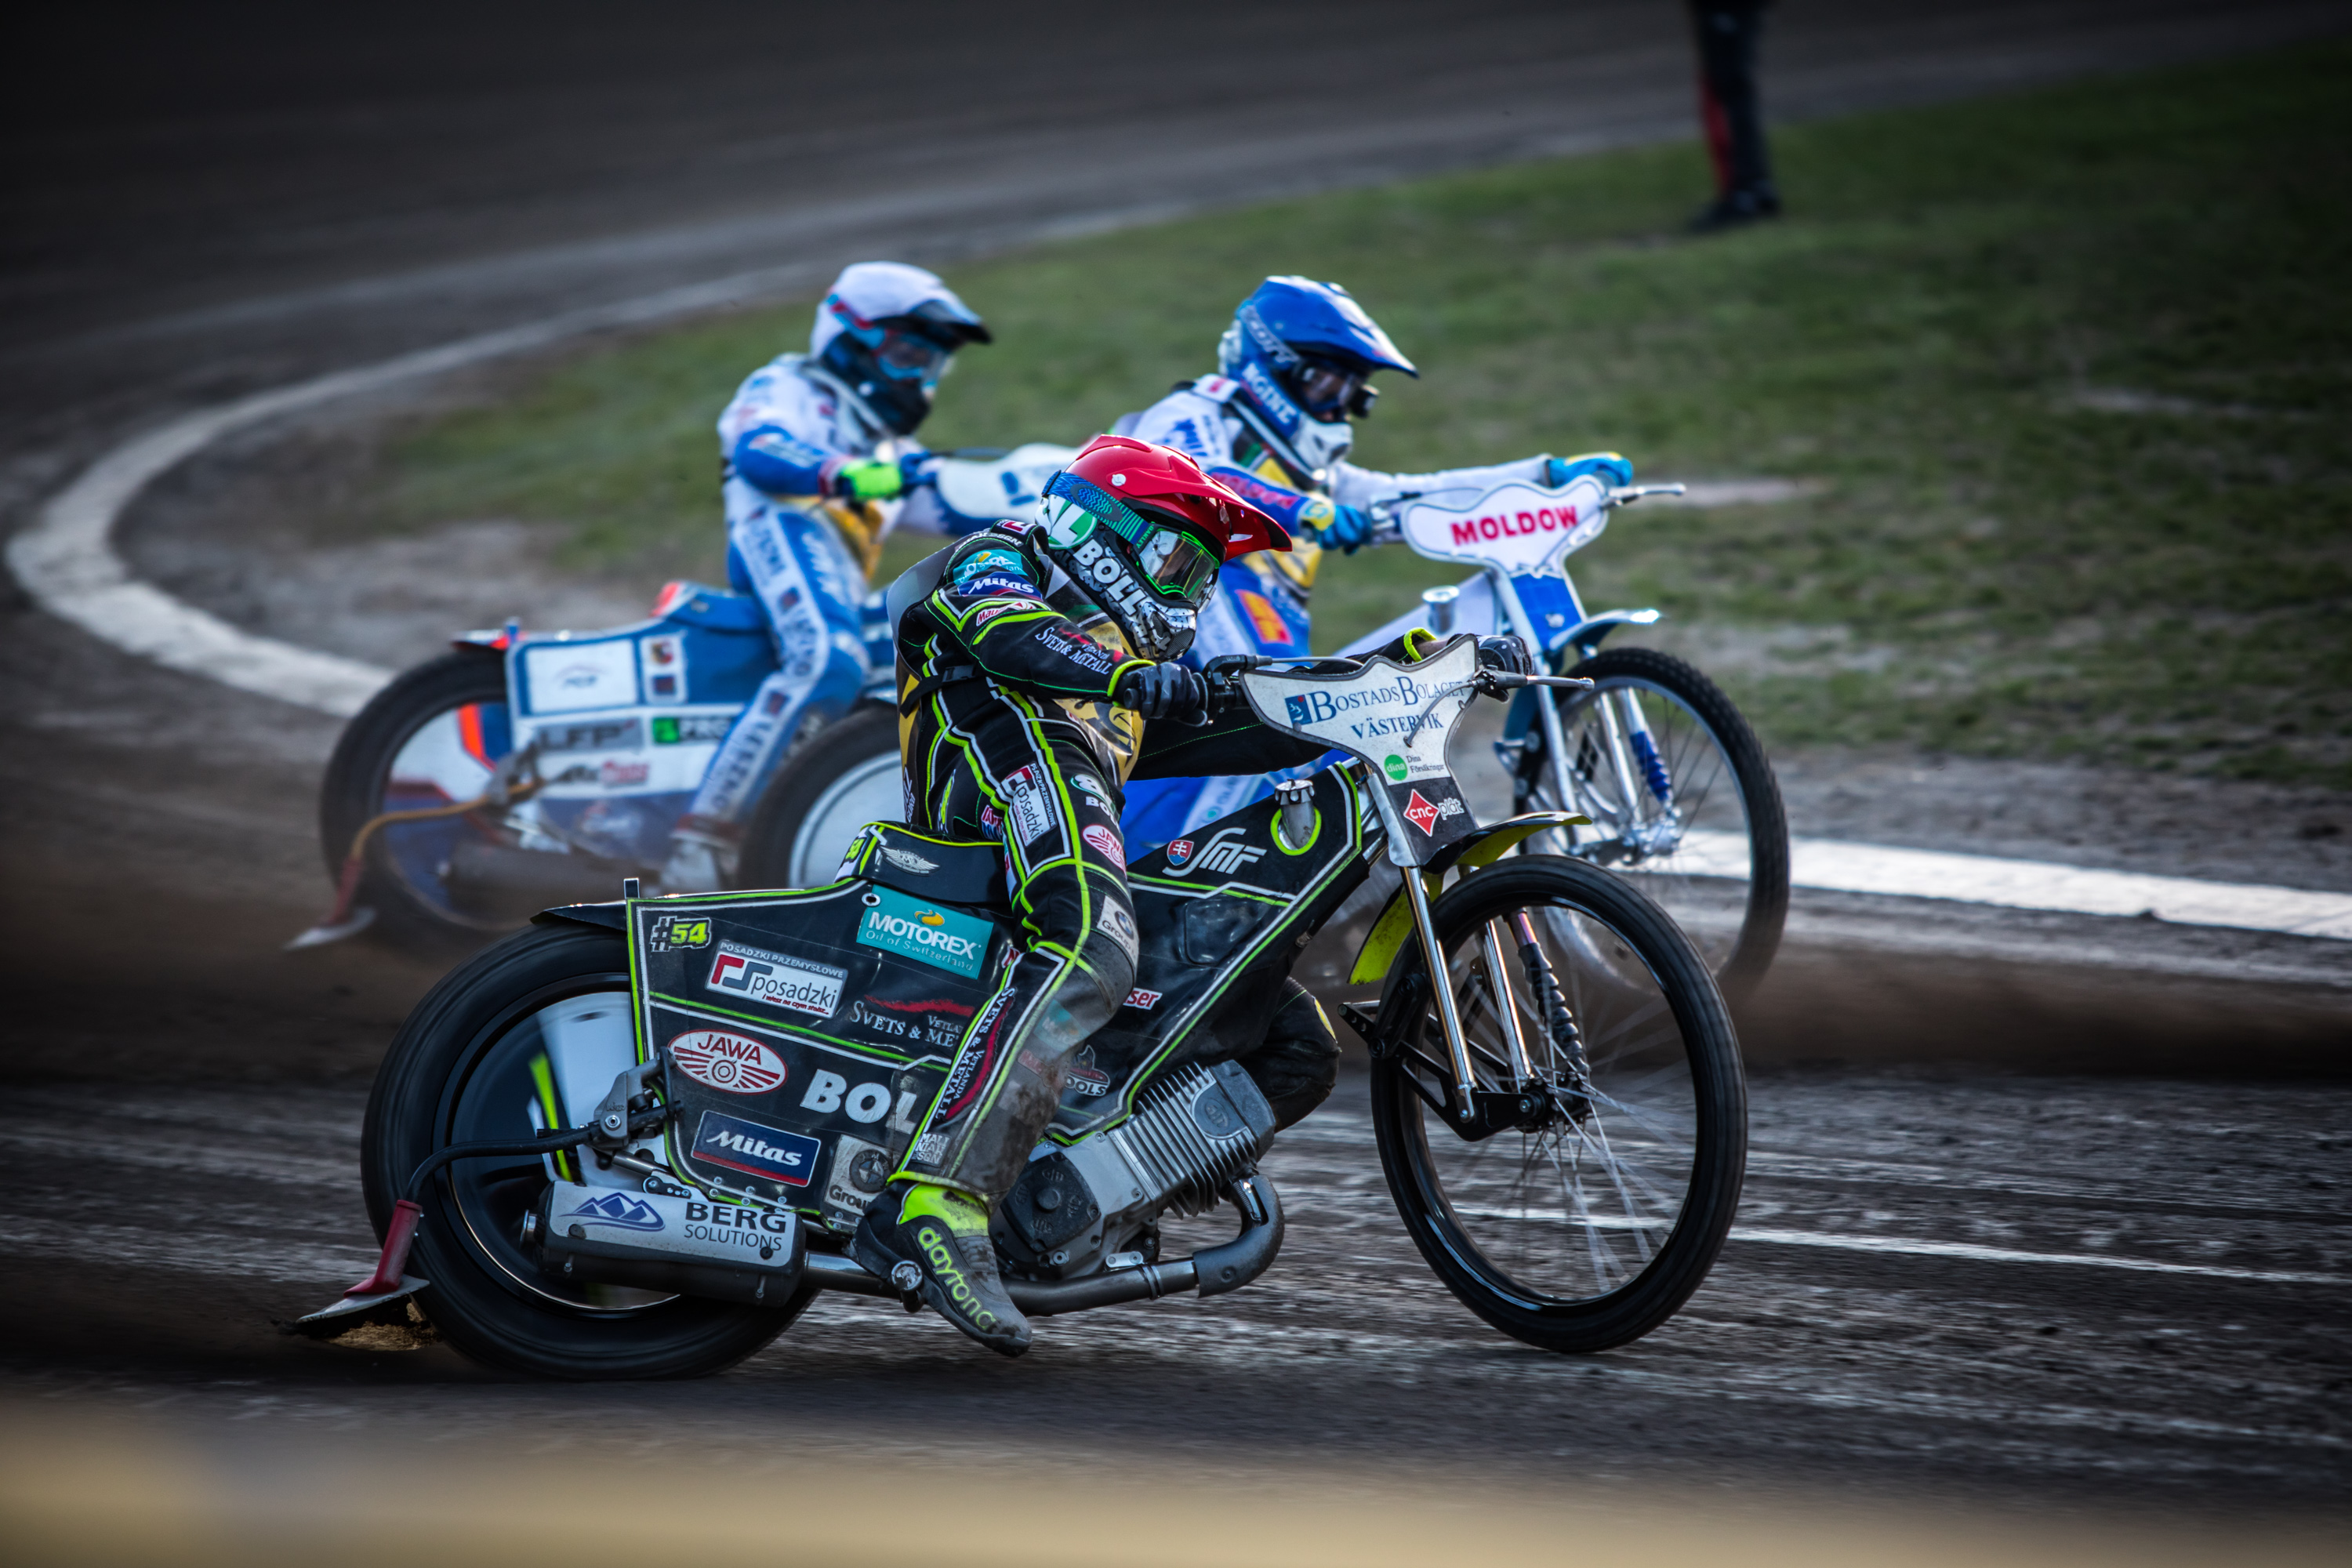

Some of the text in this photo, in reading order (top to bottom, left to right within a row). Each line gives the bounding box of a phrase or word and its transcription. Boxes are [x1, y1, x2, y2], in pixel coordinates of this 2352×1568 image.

[1136, 525, 1154, 549] OAKLEY
[1450, 506, 1579, 546] MOLDOW
[968, 577, 1034, 594] Mitas
[1073, 539, 1146, 616] BOLL
[1351, 713, 1444, 739] VÄSTERVIK
[1386, 763, 1406, 773] dina
[1406, 755, 1421, 764] Dina
[1410, 797, 1465, 820] cnc plåt
[866, 930, 974, 972] Oil of Switzerland
[868, 912, 977, 960] MOTOREX
[720, 942, 844, 979] POSADZKI PRZEMYSŁOWE
[750, 975, 837, 1009] posadzki
[978, 986, 1016, 1034] SVETS
[850, 1000, 906, 1036] SVETS
[908, 1025, 922, 1040] &
[697, 1034, 762, 1066] JAWA
[970, 1036, 982, 1048] &
[935, 1050, 971, 1121] METALL
[953, 1049, 985, 1100] VETLANDA
[800, 1069, 919, 1134] BOL
[706, 1130, 802, 1167] Mitas
[685, 1202, 788, 1234] BERG
[684, 1224, 782, 1252] SOLUTIONS
[917, 1226, 996, 1330] daytona
